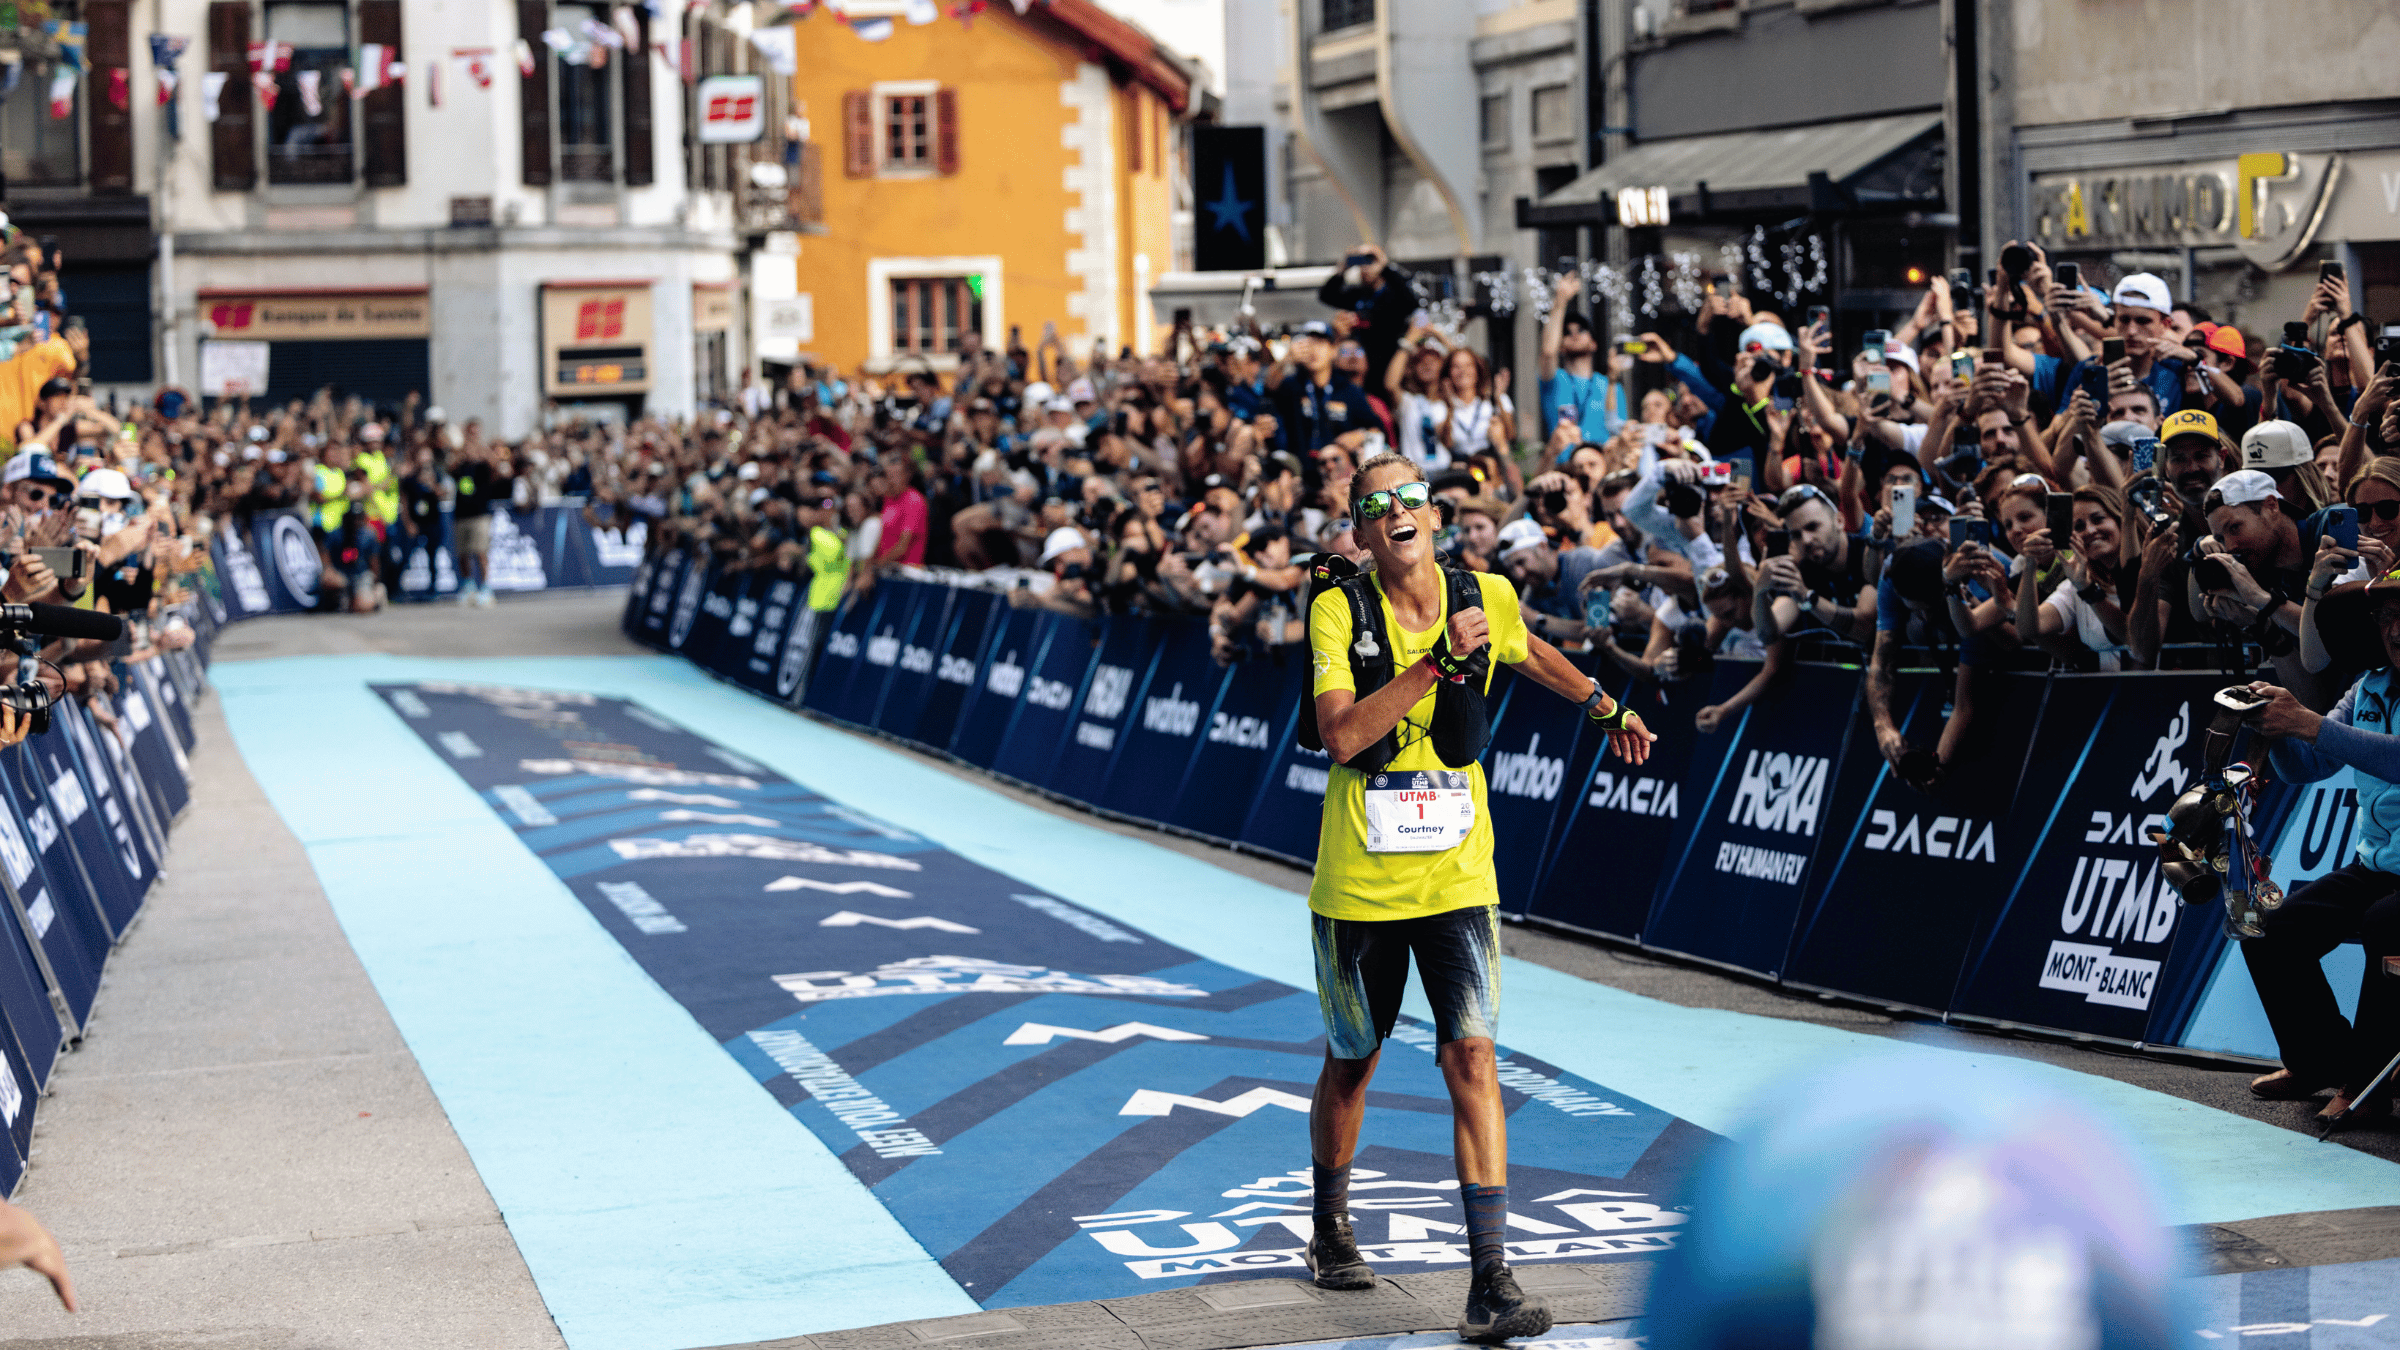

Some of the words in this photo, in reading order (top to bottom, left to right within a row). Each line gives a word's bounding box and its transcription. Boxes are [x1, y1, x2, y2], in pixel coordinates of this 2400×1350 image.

[2173, 412, 2207, 426] TOR
[1208, 711, 1269, 750] DACIA
[1491, 732, 1565, 801] wahoo
[1400, 791, 1437, 802] UTMB
[1417, 803, 1424, 820] 1
[1588, 770, 1678, 819] DACIA
[1728, 749, 1830, 837] HOKA
[1398, 825, 1444, 834] Courtney
[1864, 808, 1996, 863] DACIA
[1715, 841, 1741, 873] FLY
[1735, 845, 1786, 882] HUMAN
[1781, 853, 1808, 886] FLY
[2061, 856, 2177, 944] UTMB
[2047, 951, 2152, 999] MONT-BLANC
[825, 1097, 906, 1130] YOUR
[856, 1128, 943, 1158] MEET
